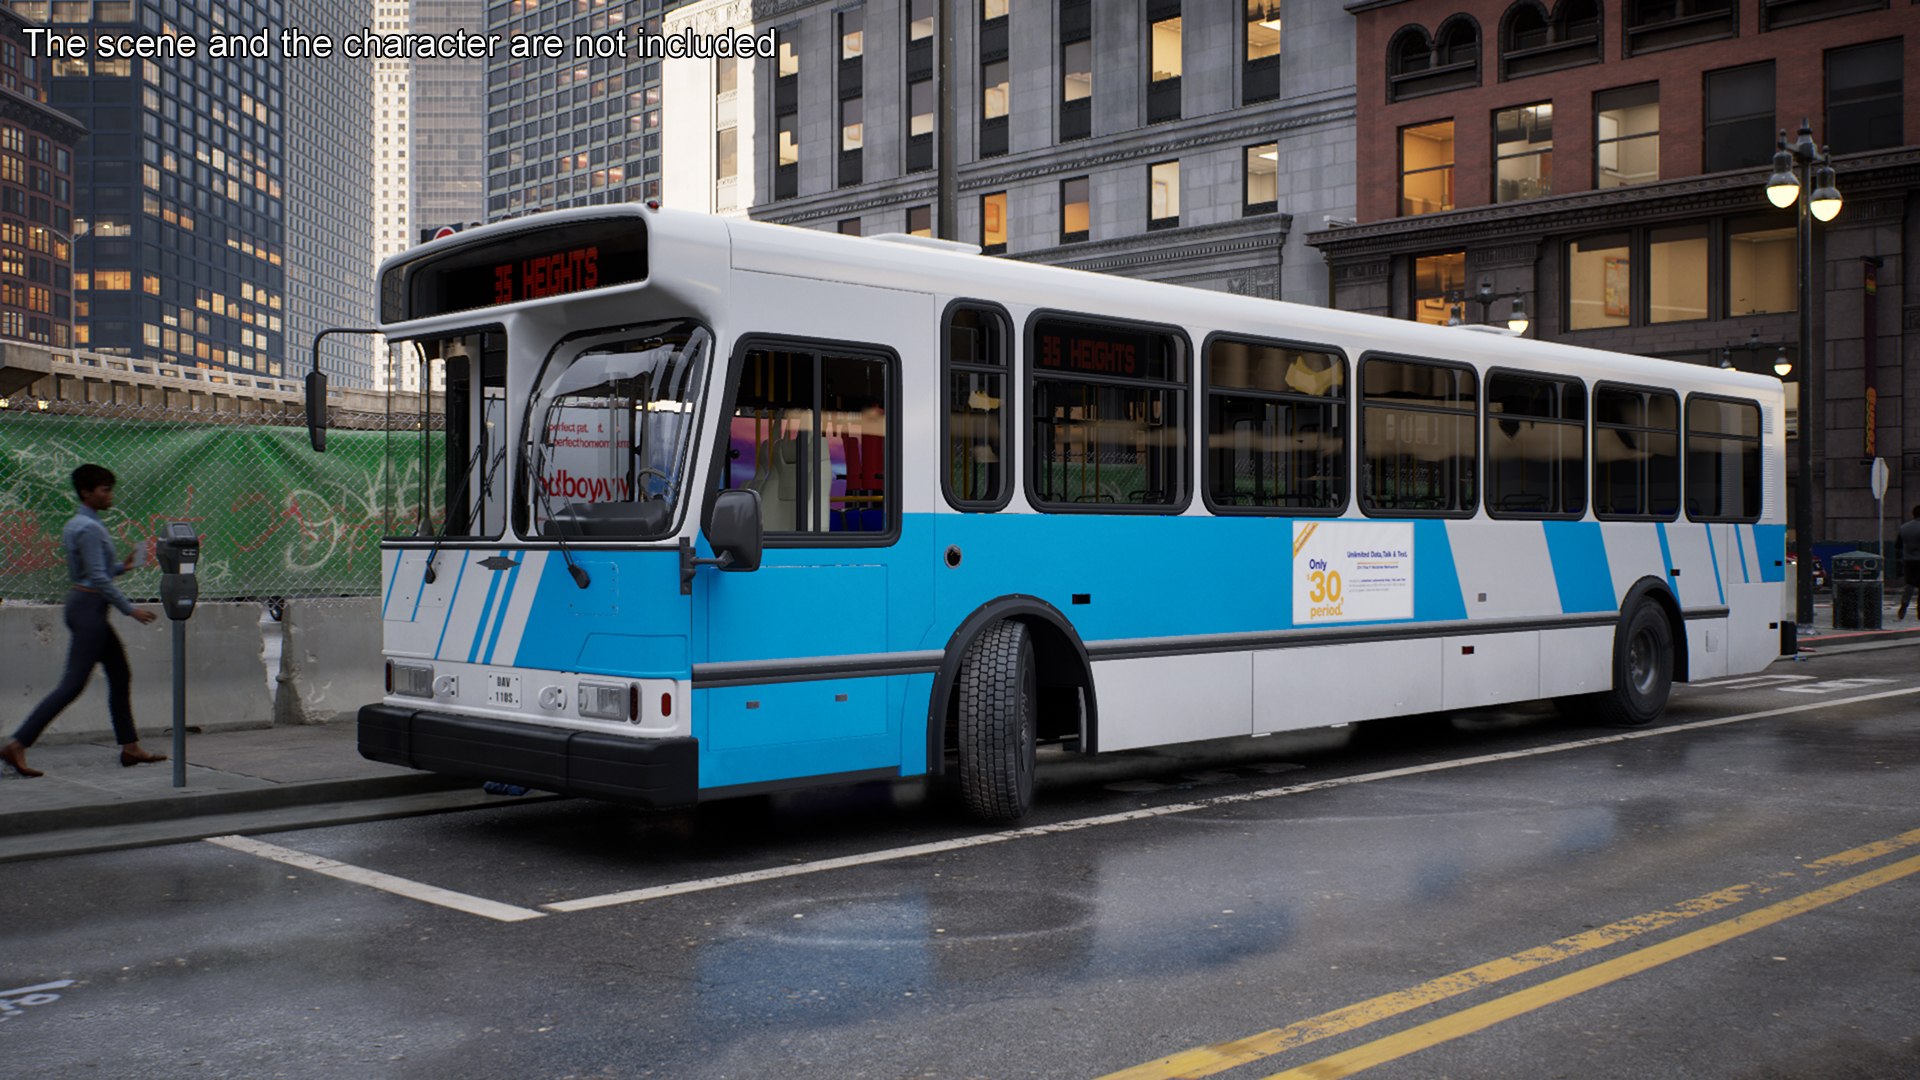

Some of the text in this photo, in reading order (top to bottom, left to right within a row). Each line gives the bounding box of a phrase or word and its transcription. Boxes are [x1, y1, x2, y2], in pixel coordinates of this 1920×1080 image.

[523, 247, 599, 302] HEIGHTS
[1070, 337, 1136, 374] HEIGHTS
[1309, 558, 1327, 571] Only
[1310, 602, 1344, 620] period.
